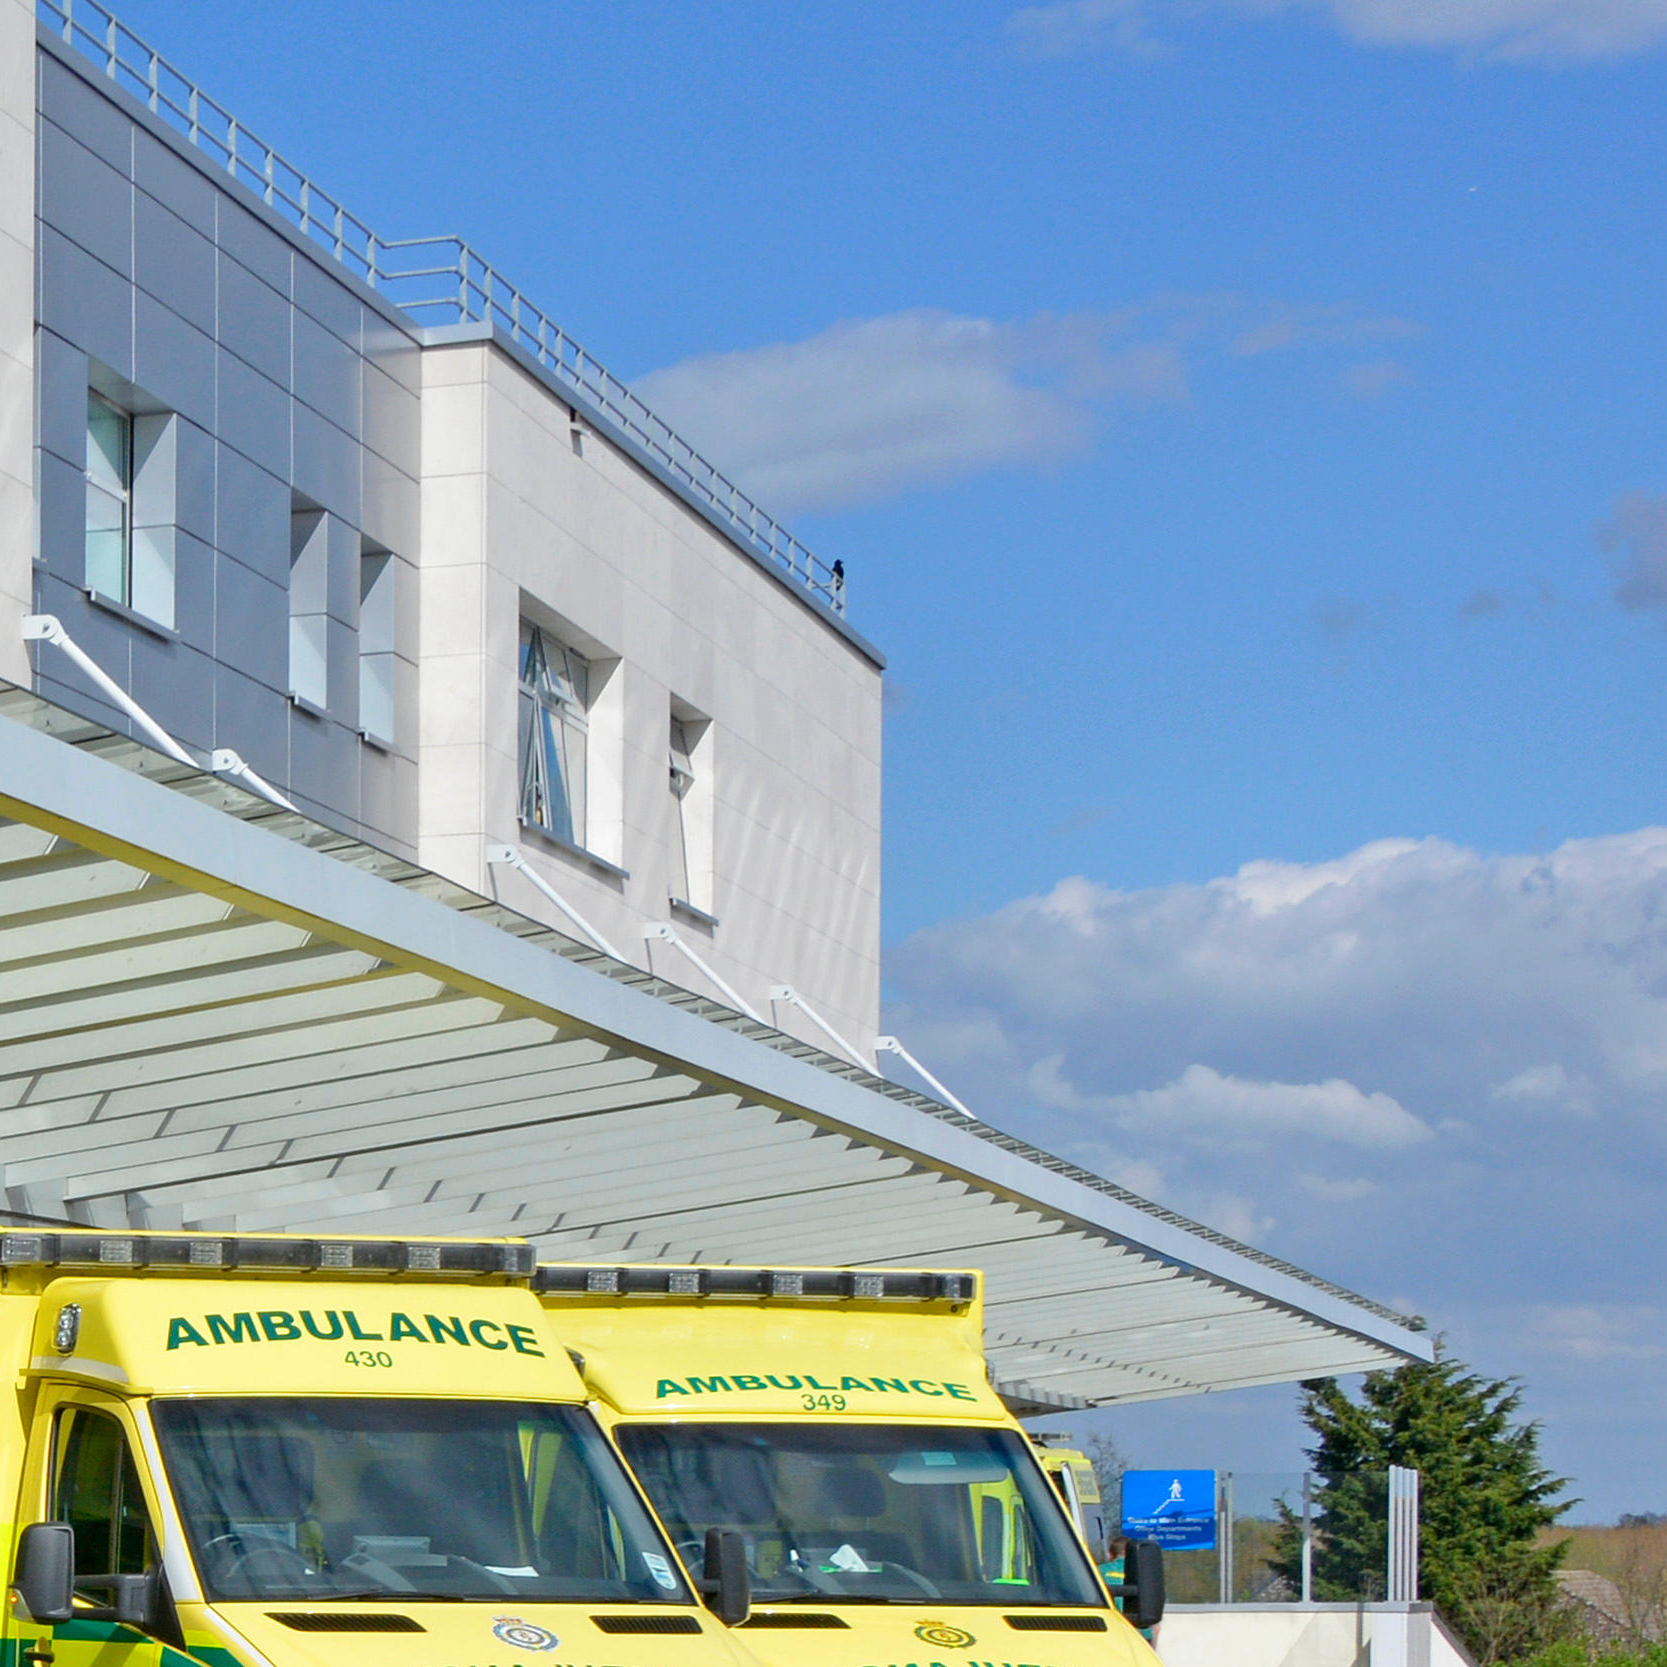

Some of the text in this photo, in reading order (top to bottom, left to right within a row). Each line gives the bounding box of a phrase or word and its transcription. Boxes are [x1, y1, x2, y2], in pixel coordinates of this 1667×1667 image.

[167, 1310, 545, 1358] AMBULANCE
[345, 1351, 393, 1368] 430
[656, 1374, 979, 1403] AMBULANCE
[803, 1394, 847, 1411] 349
